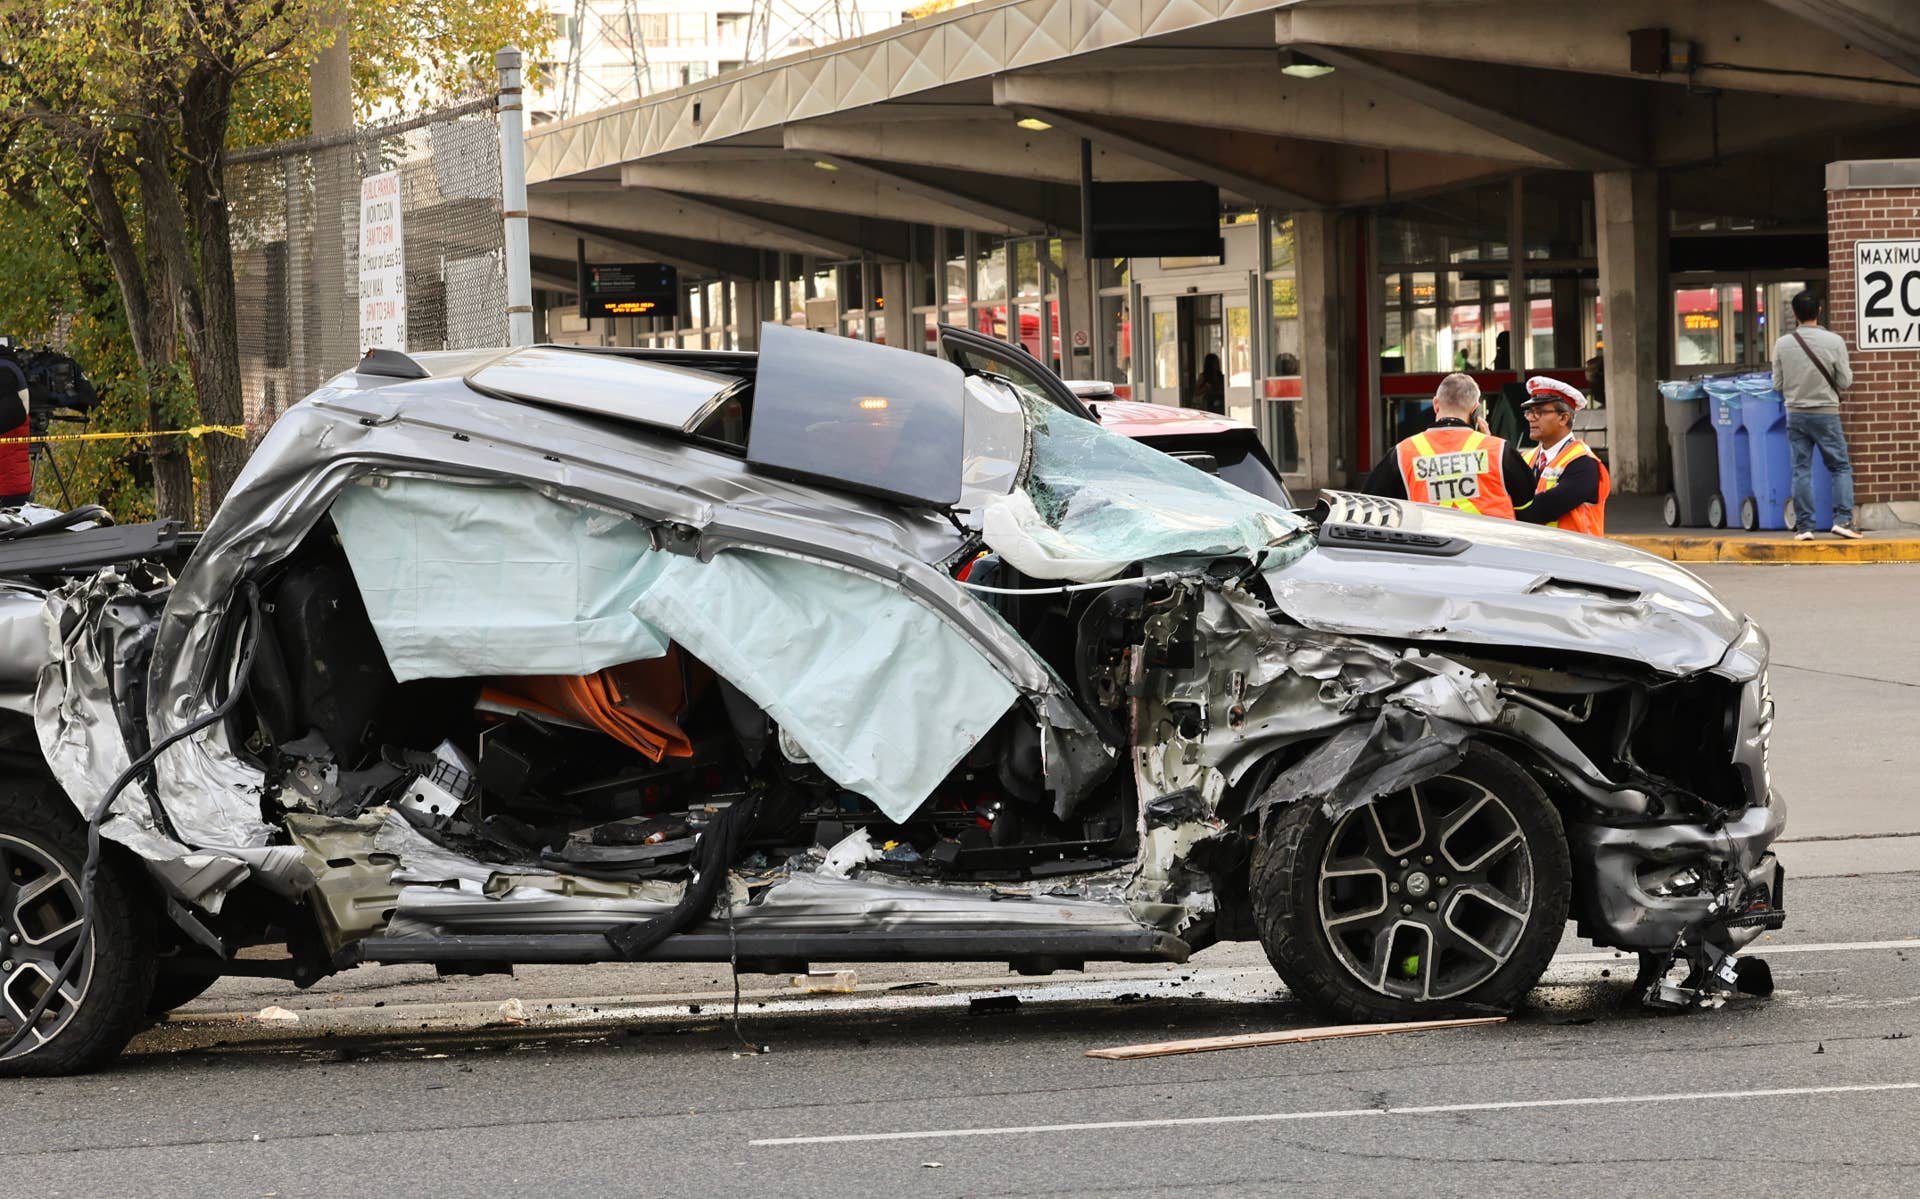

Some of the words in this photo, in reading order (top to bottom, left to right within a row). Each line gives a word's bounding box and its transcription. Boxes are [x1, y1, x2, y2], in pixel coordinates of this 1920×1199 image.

[383, 201, 394, 221] SUN
[372, 278, 383, 297] MAX
[1864, 270, 1920, 318] 20
[371, 326, 383, 345] RATE
[1868, 323, 1920, 343] km/
[1416, 452, 1484, 478] SAFETY
[1429, 477, 1476, 500] TTC
